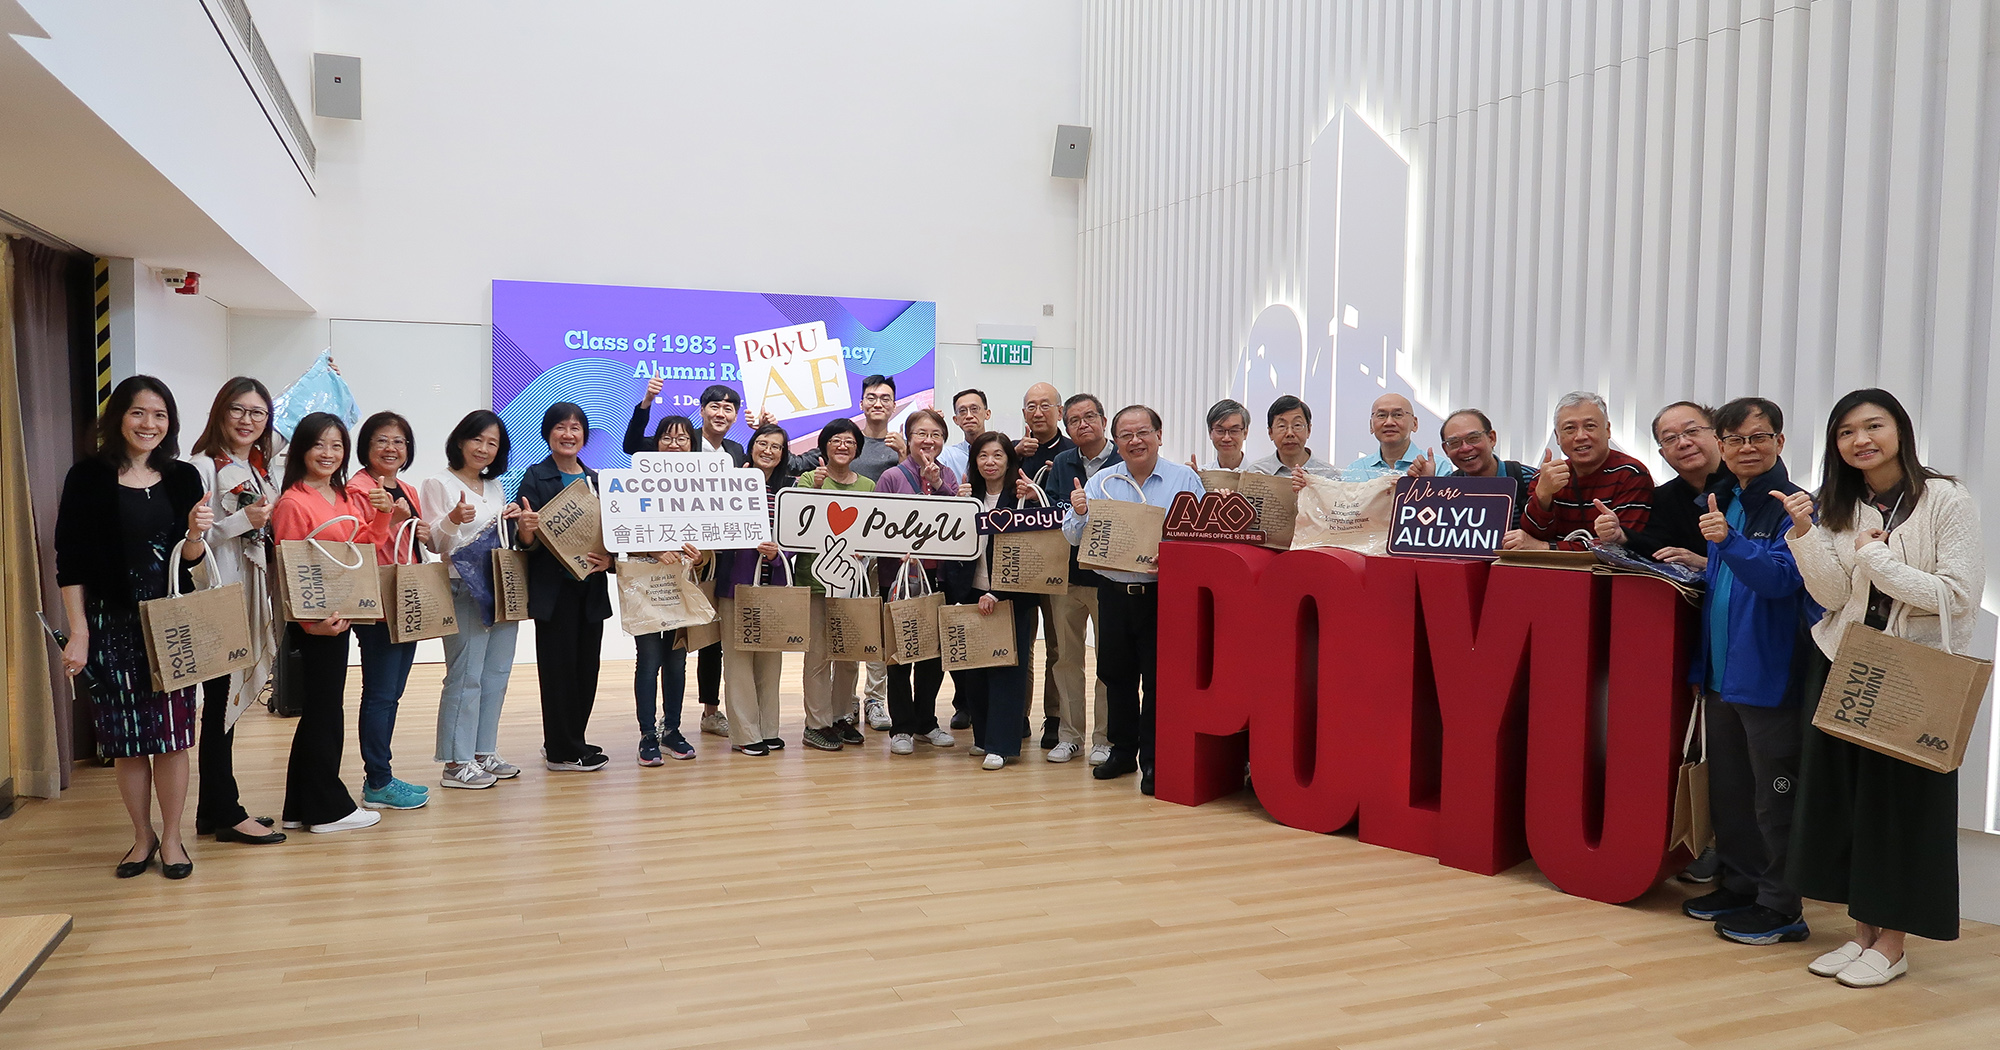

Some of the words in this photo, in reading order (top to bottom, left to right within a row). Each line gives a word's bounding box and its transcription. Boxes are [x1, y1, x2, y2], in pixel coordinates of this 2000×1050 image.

[564, 330, 629, 352] Class
[636, 333, 657, 352] of
[661, 334, 717, 354] 1983
[743, 328, 817, 365] PolyU
[981, 343, 1008, 363] EXIT
[1009, 344, 1031, 364] 出口
[633, 360, 716, 381] Alumni
[757, 355, 839, 419] AF
[673, 395, 681, 406] 1
[639, 458, 701, 473] School
[709, 459, 725, 472] of
[608, 477, 759, 493] ACCOUNTING
[1404, 478, 1435, 504] We
[1437, 487, 1461, 500] are
[546, 500, 577, 530] POLYU
[553, 507, 584, 538] ALUMNI
[609, 501, 621, 514] &
[640, 497, 761, 512] FINANCE
[980, 516, 989, 530] I
[1014, 510, 1065, 528] PolyU
[1247, 497, 1264, 530] LUMNI
[1400, 506, 1486, 528] POLYU
[612, 521, 764, 544] 會計及金融學院
[862, 508, 966, 550] PolyU
[1088, 520, 1102, 557] POLYU
[1099, 520, 1112, 558] ALUMNI
[1395, 526, 1499, 549] ALUMNI
[1001, 546, 1011, 584] POLYU
[1011, 546, 1020, 584] ALUMNI
[297, 565, 315, 609] POLYU
[310, 564, 326, 608] ALUMNI
[405, 589, 414, 633] POLYU
[413, 589, 421, 631] ALUMNI
[743, 607, 752, 644] POLYU
[753, 607, 761, 644] ALUMNI
[165, 627, 185, 679] POLYU
[179, 624, 197, 674] ALUMNI
[836, 617, 845, 653] ALUMNI
[902, 620, 913, 658] POLYU
[911, 619, 919, 656] ALUMNI
[948, 626, 958, 663] POLYU
[957, 625, 967, 661] ALUMNI
[1834, 661, 1869, 723] POLYU
[1853, 667, 1887, 728] ALUMNI
[1155, 540, 1690, 904] POLYU
